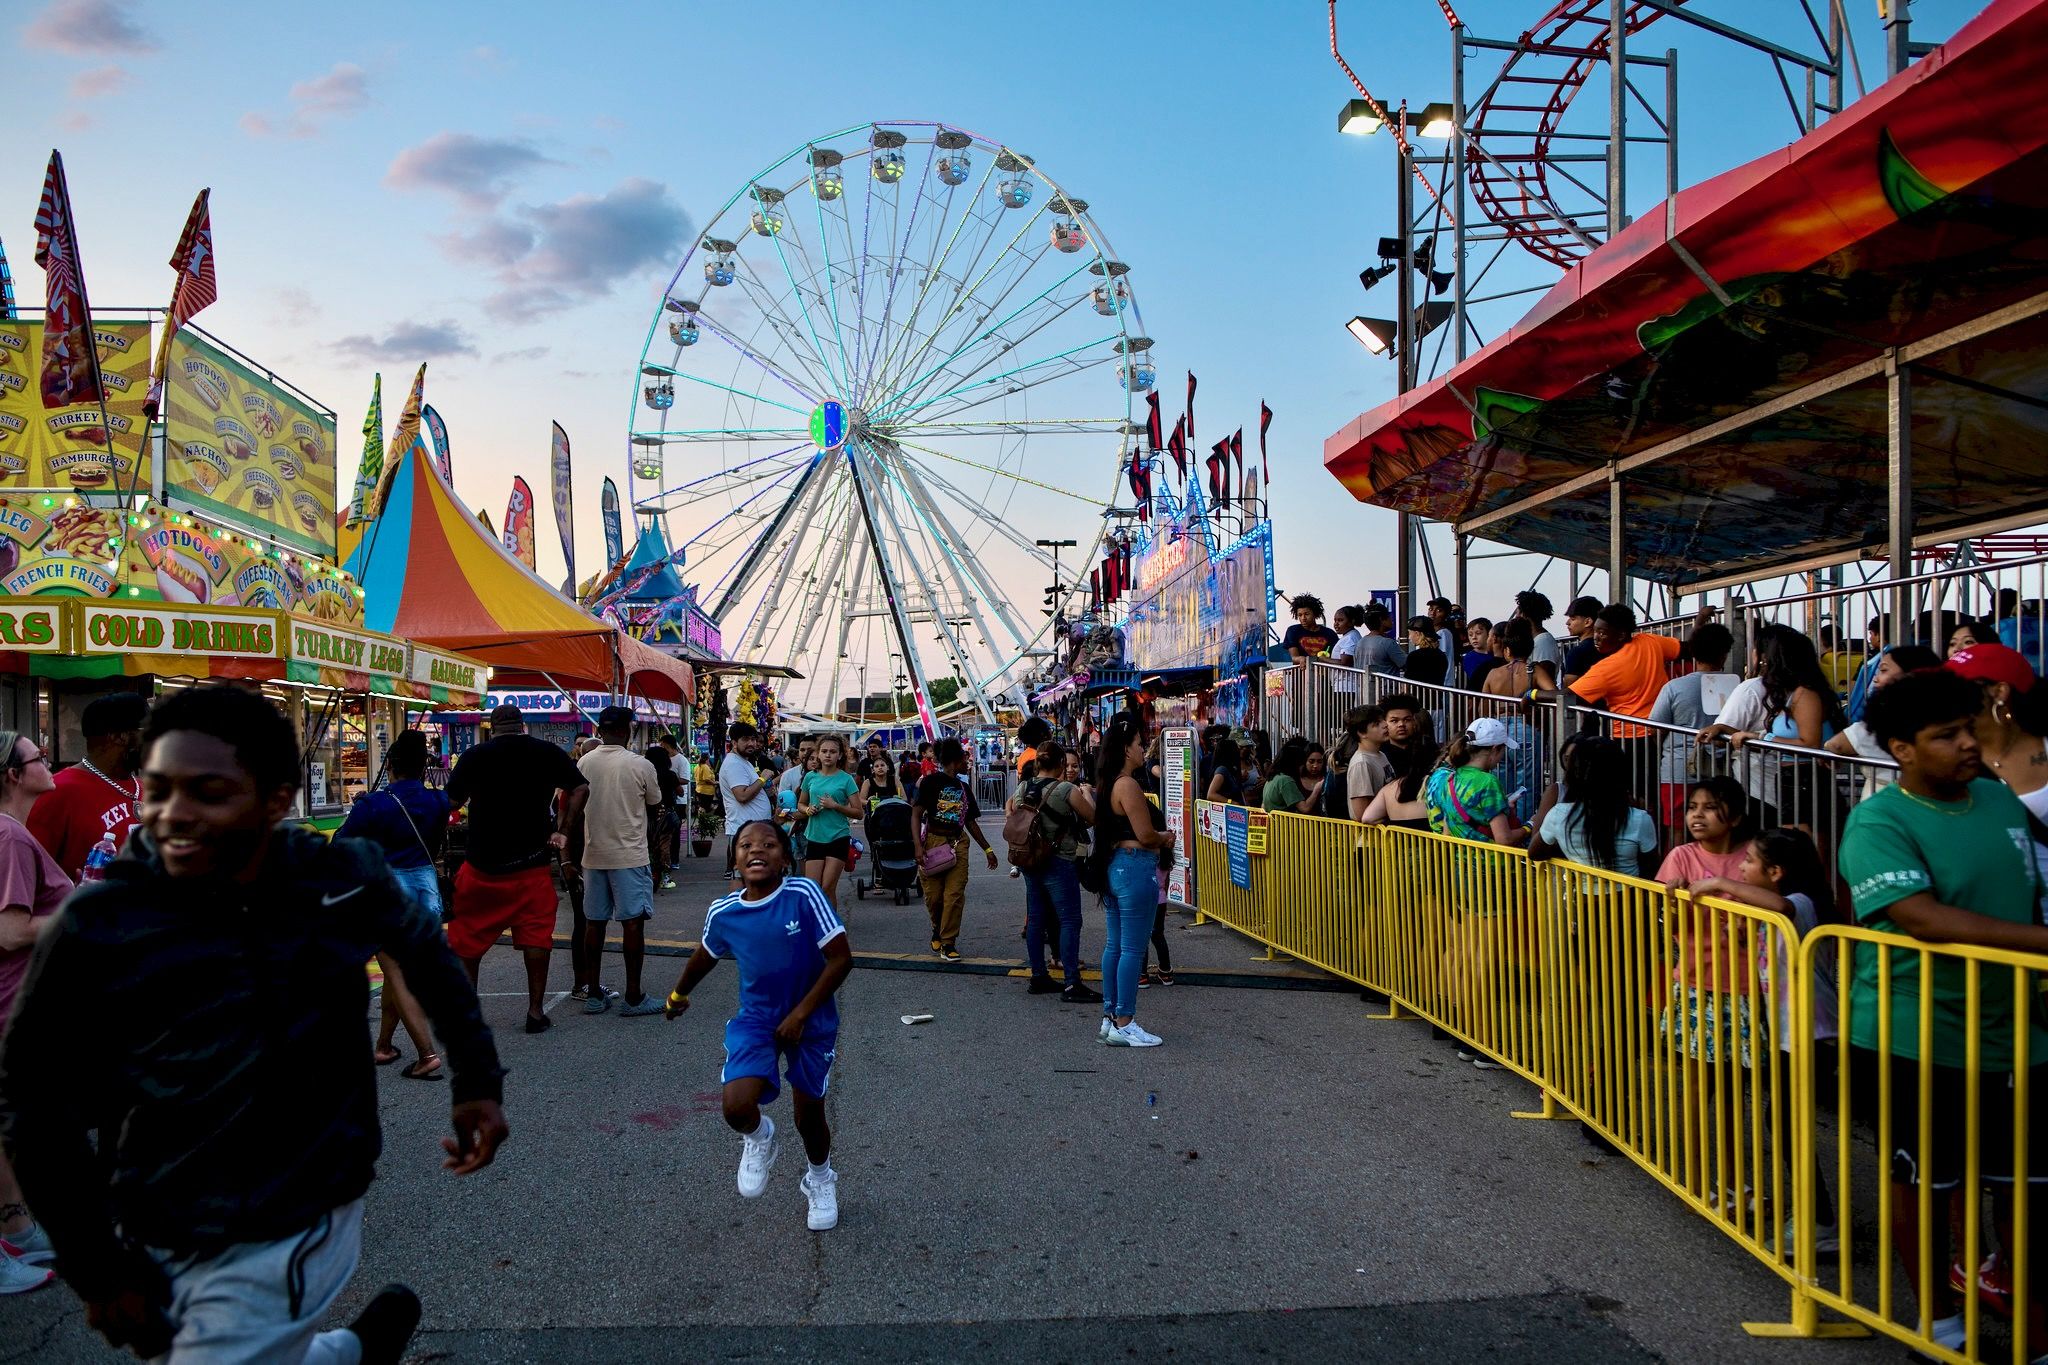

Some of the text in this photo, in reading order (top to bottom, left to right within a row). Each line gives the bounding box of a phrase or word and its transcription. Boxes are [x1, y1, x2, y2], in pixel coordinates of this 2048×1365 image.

[185, 362, 227, 393] HOTDOGS
[243, 396, 265, 408] FRENCH
[51, 412, 99, 428] TURKEY
[185, 445, 228, 473] NACHOS
[245, 471, 281, 497] CHEESESTEAK
[0, 508, 32, 533] LEG
[146, 529, 221, 570] HOTDOGS
[9, 564, 110, 593] FRENCH FRIES
[238, 563, 292, 604] CHEESESTEAK
[306, 577, 353, 609] NACHOS
[88, 613, 273, 654] COLD DRINKS
[295, 626, 404, 674] TURKEY LEGS
[430, 658, 475, 688] SAUSAGE
[503, 693, 566, 710] OREOS
[101, 802, 130, 831] KEY
